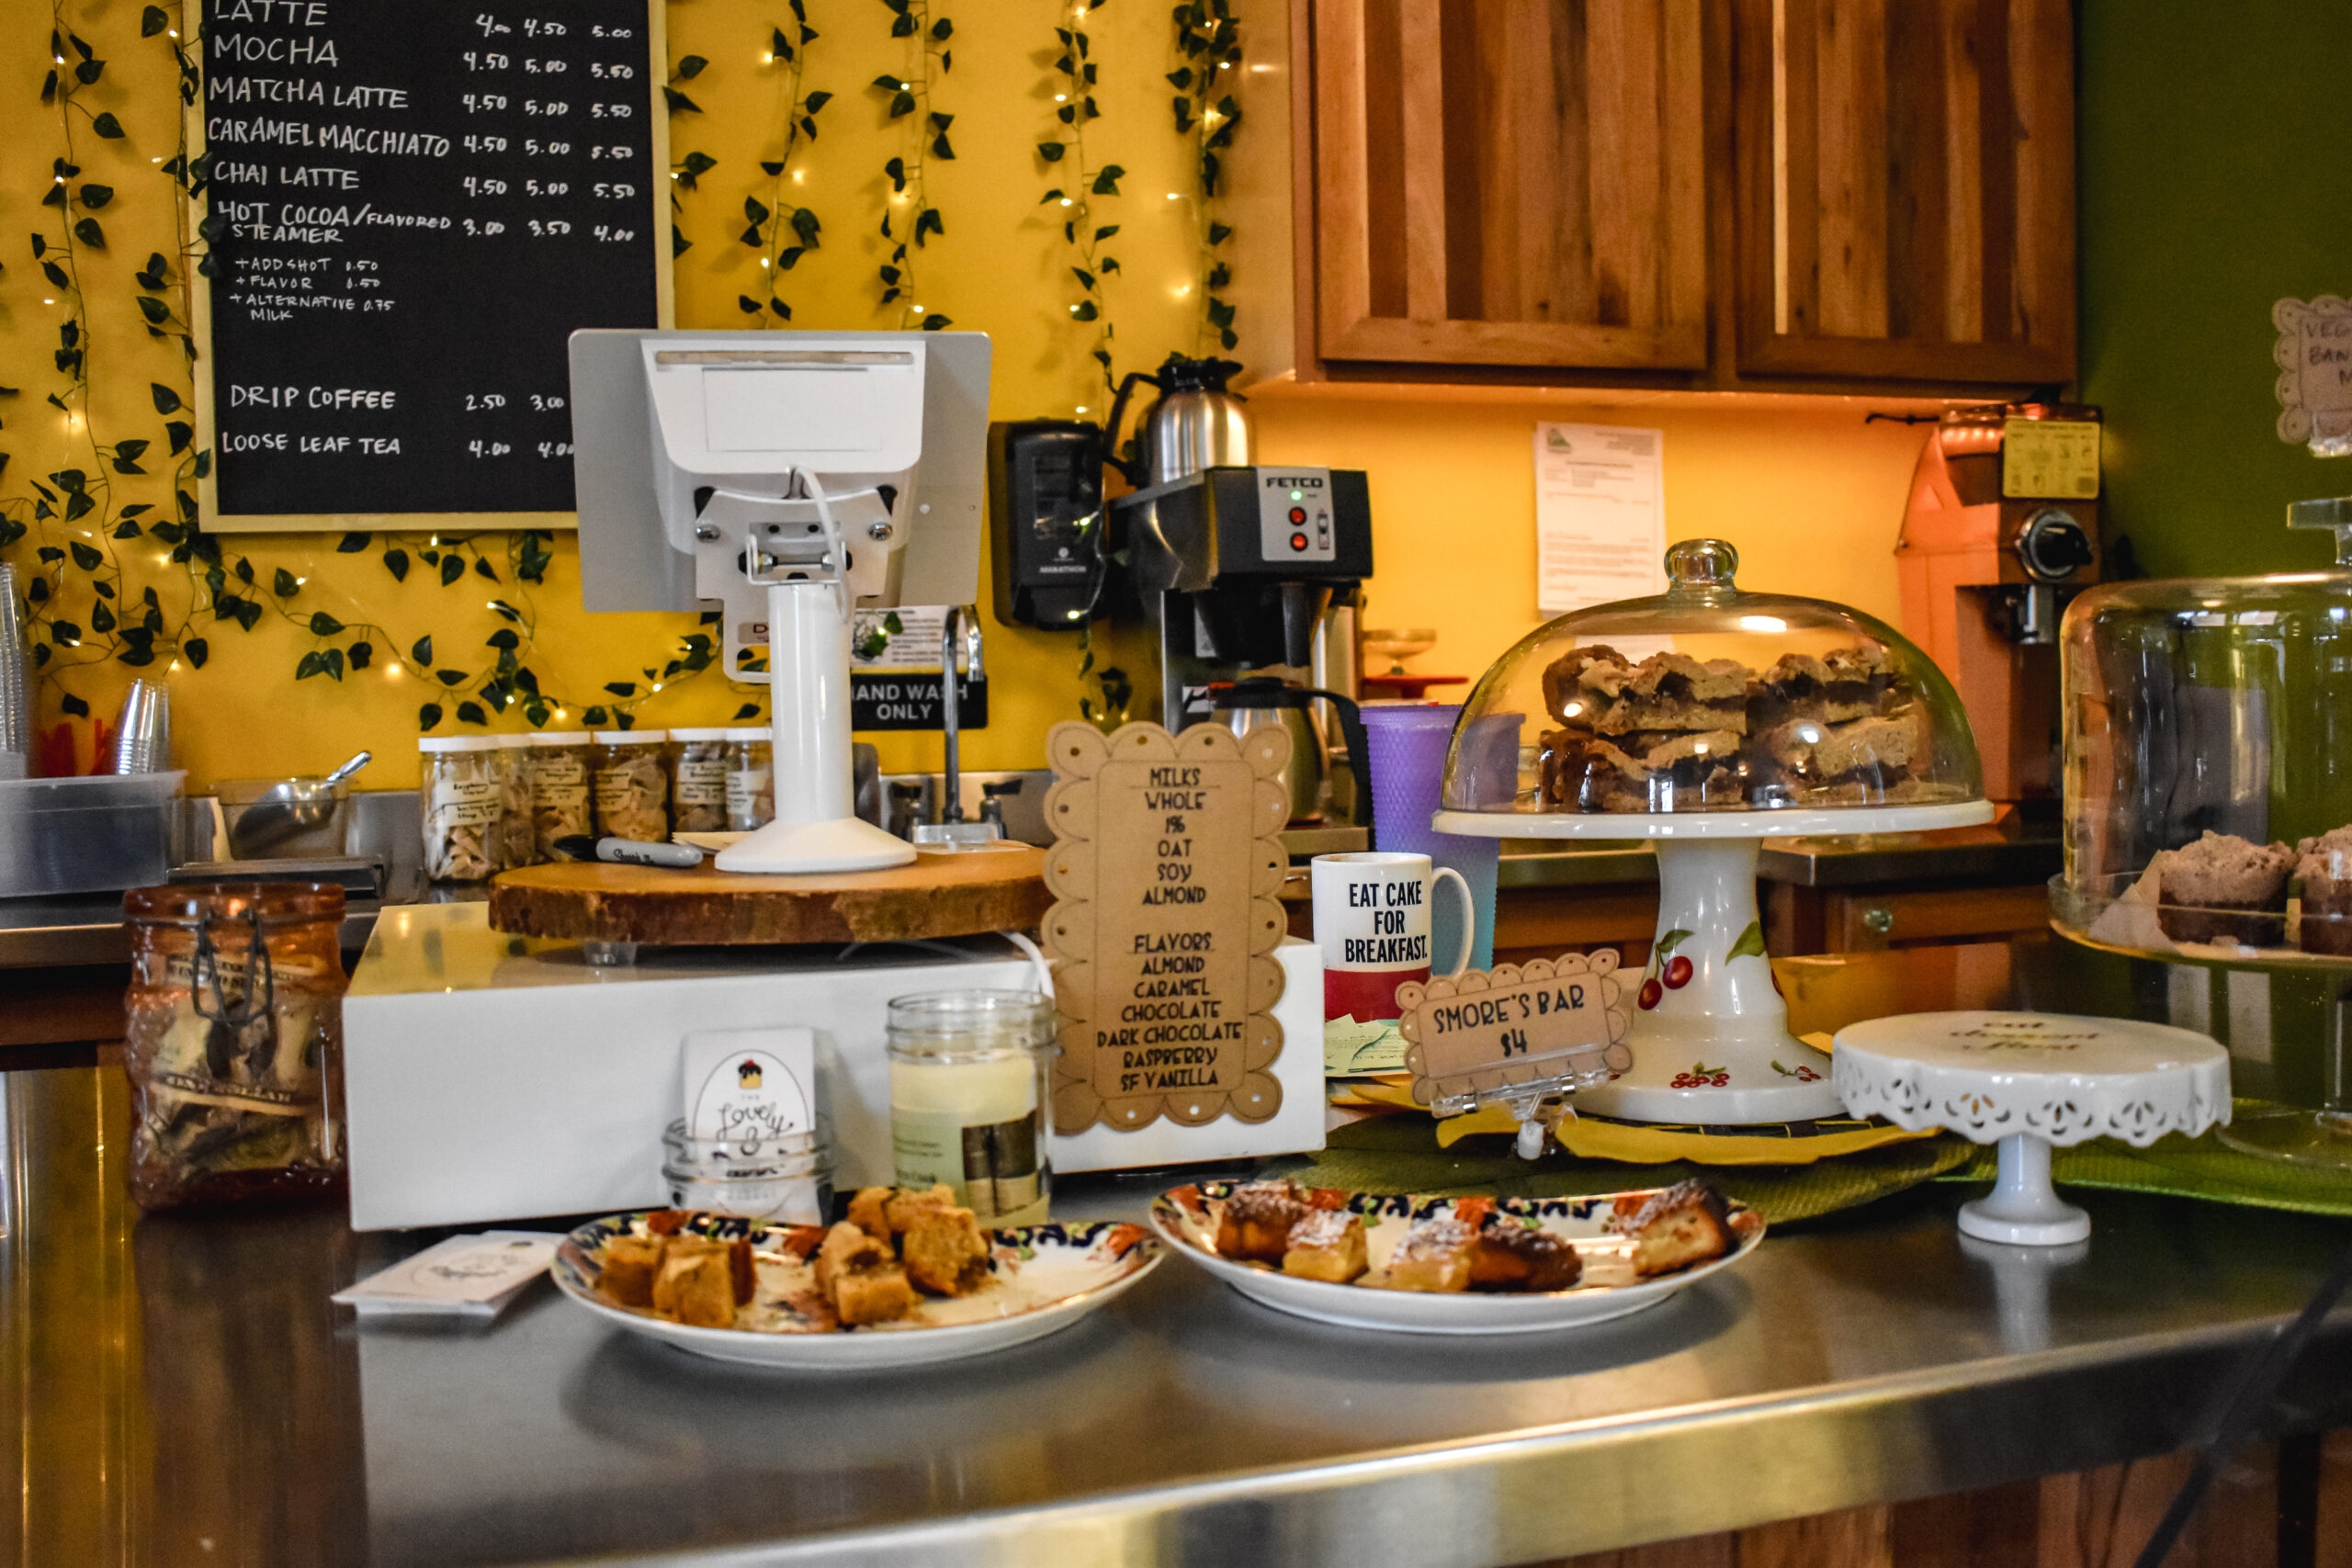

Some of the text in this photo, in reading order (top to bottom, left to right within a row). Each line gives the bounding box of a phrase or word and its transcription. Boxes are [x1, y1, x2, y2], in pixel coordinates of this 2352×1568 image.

[213, 0, 327, 26] LATTE
[524, 17, 567, 37] 4.50
[592, 25, 632, 39] 5.00
[214, 34, 634, 81] MOCHA 4.50 5.00 5.50
[209, 76, 633, 118] MATCHA LATTE 4.50 5.00 5.50
[208, 117, 634, 161] CARAMEL MACCHIATO 4.50 5.00 5.50
[214, 161, 636, 199] CHAI LATTE 4.50 5.00 5.50
[218, 200, 270, 227] HOT
[463, 220, 505, 237] 3.00
[528, 220, 571, 237] 3.50
[594, 225, 635, 243] 4.00
[232, 223, 344, 245] STEAMER
[250, 275, 313, 289] FLAVOR
[245, 293, 356, 310] ALTERNATIVE
[363, 299, 396, 312] 0.75
[250, 308, 294, 321] MILK
[230, 384, 565, 412] DRIP COFFEE 2.50 3.00
[221, 432, 288, 454] LOOSE
[300, 435, 351, 455] LEAF
[358, 436, 401, 456] TEA
[469, 440, 512, 458] 4.00
[1266, 477, 1324, 489] FETCO
[851, 684, 900, 701] AND
[876, 704, 933, 720] ONLY
[1149, 767, 1201, 788] MILKS
[1144, 792, 1206, 811] WHOLE
[1165, 815, 1185, 834] 1%
[1157, 839, 1193, 858] OAT
[1157, 863, 1193, 883] SOY
[1142, 886, 1206, 906] ALMOND
[1349, 880, 1423, 908] EAT CAKE
[1374, 910, 1406, 936] FOR
[1134, 932, 1213, 954] FLAVORS
[1345, 935, 1428, 964] BREAKFAST.
[1141, 956, 1205, 976] ALMOND
[1133, 977, 1211, 999] CARAMEL
[1121, 1000, 1223, 1023] CHOCOLATE
[1433, 984, 1585, 1034] SMORE'S BAR
[1096, 1021, 1244, 1048] DARK CHOCOLATE
[1499, 1028, 1529, 1058] $4
[1123, 1047, 1218, 1069] RASPBERRY
[1120, 1069, 1218, 1092] SF VANILLA
